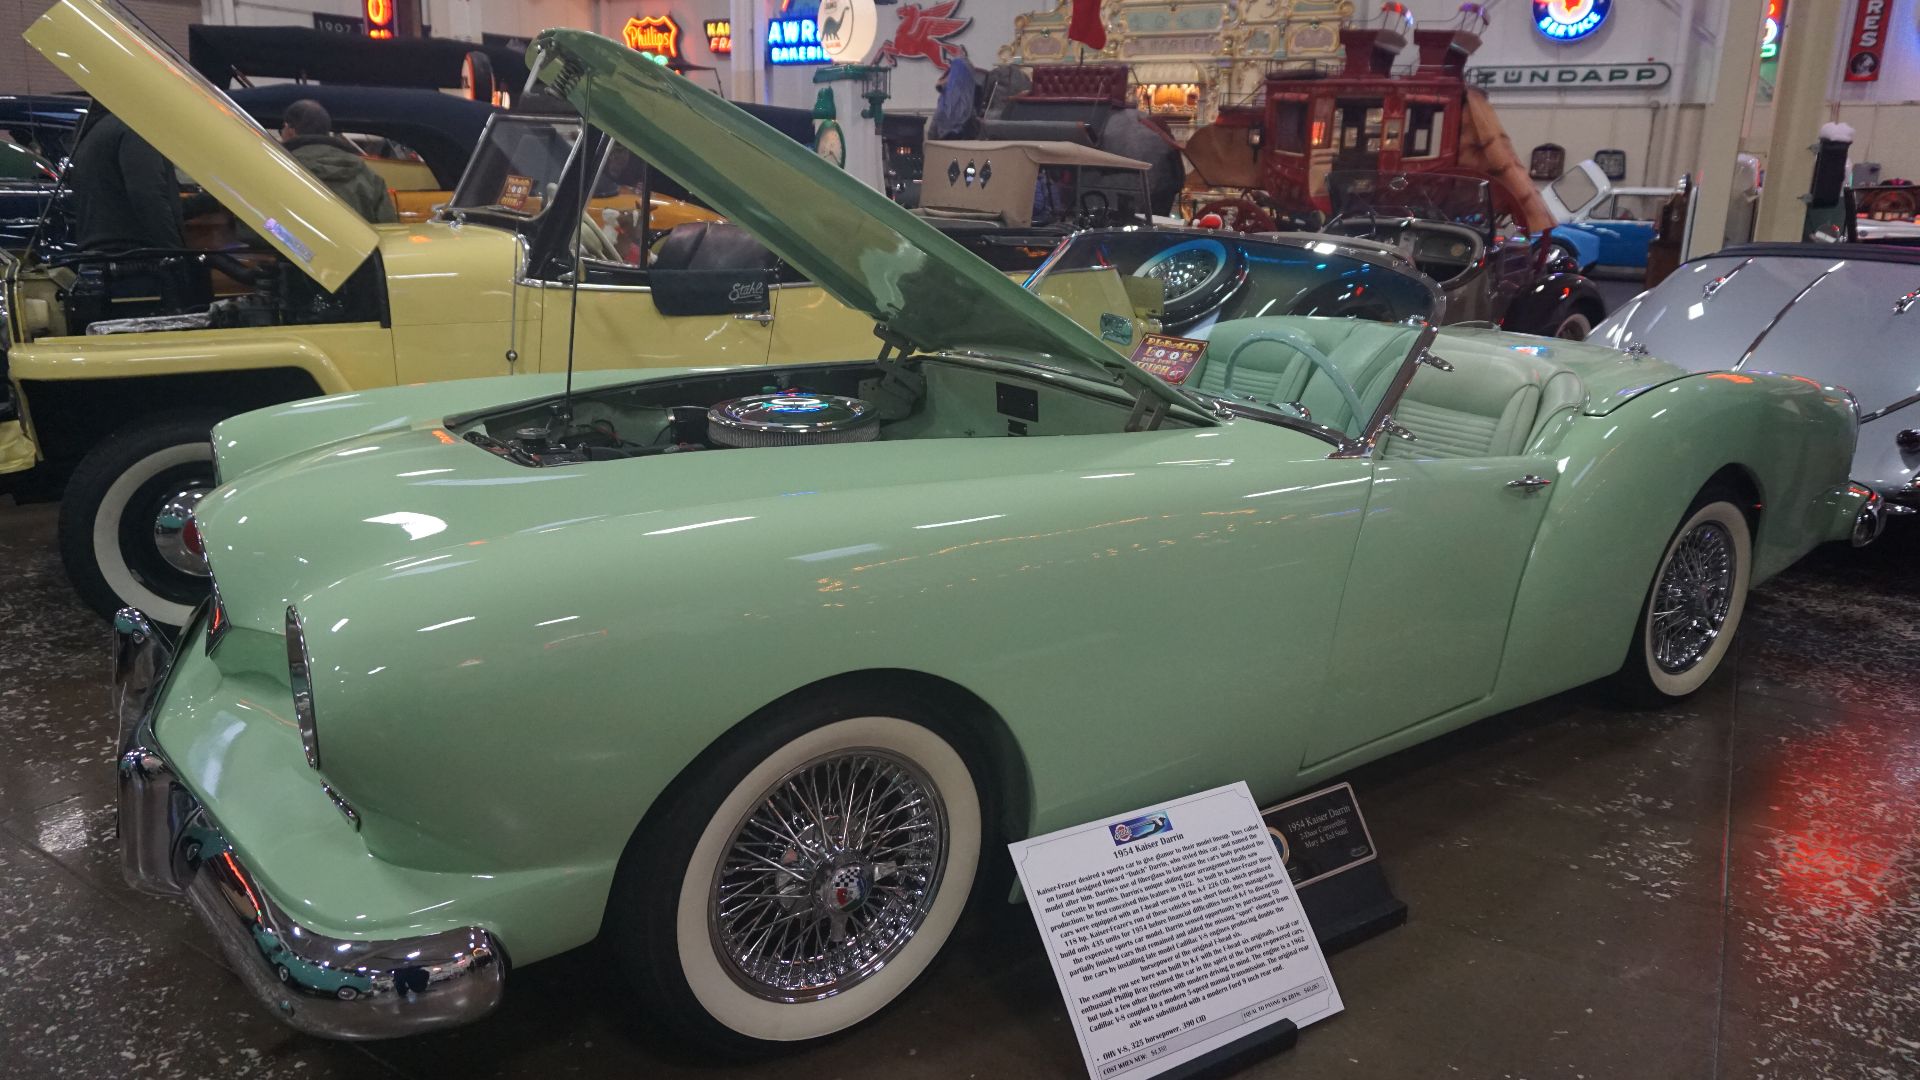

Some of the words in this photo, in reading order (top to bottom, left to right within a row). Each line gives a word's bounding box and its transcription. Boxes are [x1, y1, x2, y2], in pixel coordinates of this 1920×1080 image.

[768, 19, 821, 44] AWR
[1539, 12, 1600, 37] SERVICE
[627, 26, 669, 52] Phillips
[1477, 68, 1657, 85] ZÜNDAPP
[1287, 820, 1305, 833] 1954
[1305, 814, 1328, 826] Kaiser
[1327, 805, 1350, 818] Darrin
[1113, 846, 1134, 859] 1954
[1134, 840, 1159, 853] Kaiser
[1159, 832, 1184, 845] Darrin
[1078, 996, 1091, 1005] The
[1091, 986, 1117, 1000] example
[1117, 982, 1130, 992] you
[1129, 978, 1141, 986] see
[1140, 972, 1155, 982] here
[1155, 968, 1168, 977] was
[1167, 962, 1182, 972] built
[1189, 955, 1199, 964] K-F
[1200, 950, 1213, 960] with
[1212, 948, 1222, 956] the
[1222, 939, 1241, 952] F-head
[1241, 937, 1250, 945] six
[1249, 928, 1276, 942] originally.
[1275, 921, 1291, 932] Local
[1290, 919, 1299, 927] car
[1080, 997, 1113, 1015] enthusiast
[1113, 990, 1134, 1002] Phillip
[1133, 985, 1149, 995] Bray
[1149, 974, 1175, 989] restored
[1174, 972, 1184, 980] the
[1185, 968, 1195, 976] car
[1202, 961, 1212, 970] the
[1212, 955, 1228, 966] spirit
[1244, 943, 1263, 954] Darrin
[1262, 931, 1291, 947] re-powered
[1291, 927, 1305, 936] cars,
[1086, 1013, 1099, 1023] but
[1098, 1007, 1114, 1019] took
[1119, 1002, 1131, 1011] few
[1131, 996, 1148, 1007] other
[1148, 987, 1173, 1000] liberties
[1172, 981, 1186, 990] with
[1186, 973, 1209, 986] modern
[1209, 964, 1230, 977] driving
[1235, 956, 1251, 967] mind.
[1250, 952, 1262, 961] The
[1262, 946, 1280, 957] engine
[1089, 1019, 1114, 1033] Cadillac
[1114, 1014, 1126, 1023] V-8
[1126, 1004, 1151, 1019] coupled
[1163, 992, 1187, 1005] modern
[1186, 981, 1209, 996] 5-speed
[1209, 973, 1231, 987] manual
[1230, 961, 1267, 979] transmission.
[1266, 957, 1277, 965] The
[1277, 947, 1298, 961] original
[1298, 944, 1309, 952] rear
[1129, 1019, 1142, 1029] axle
[1142, 1014, 1155, 1023] was
[1155, 1000, 1188, 1018] substituted
[1187, 996, 1201, 1005] with
[1206, 986, 1229, 999] modern
[1227, 979, 1242, 990] Ford
[1246, 973, 1260, 983] inch
[1259, 969, 1272, 978] rear
[1272, 963, 1284, 973] end.
